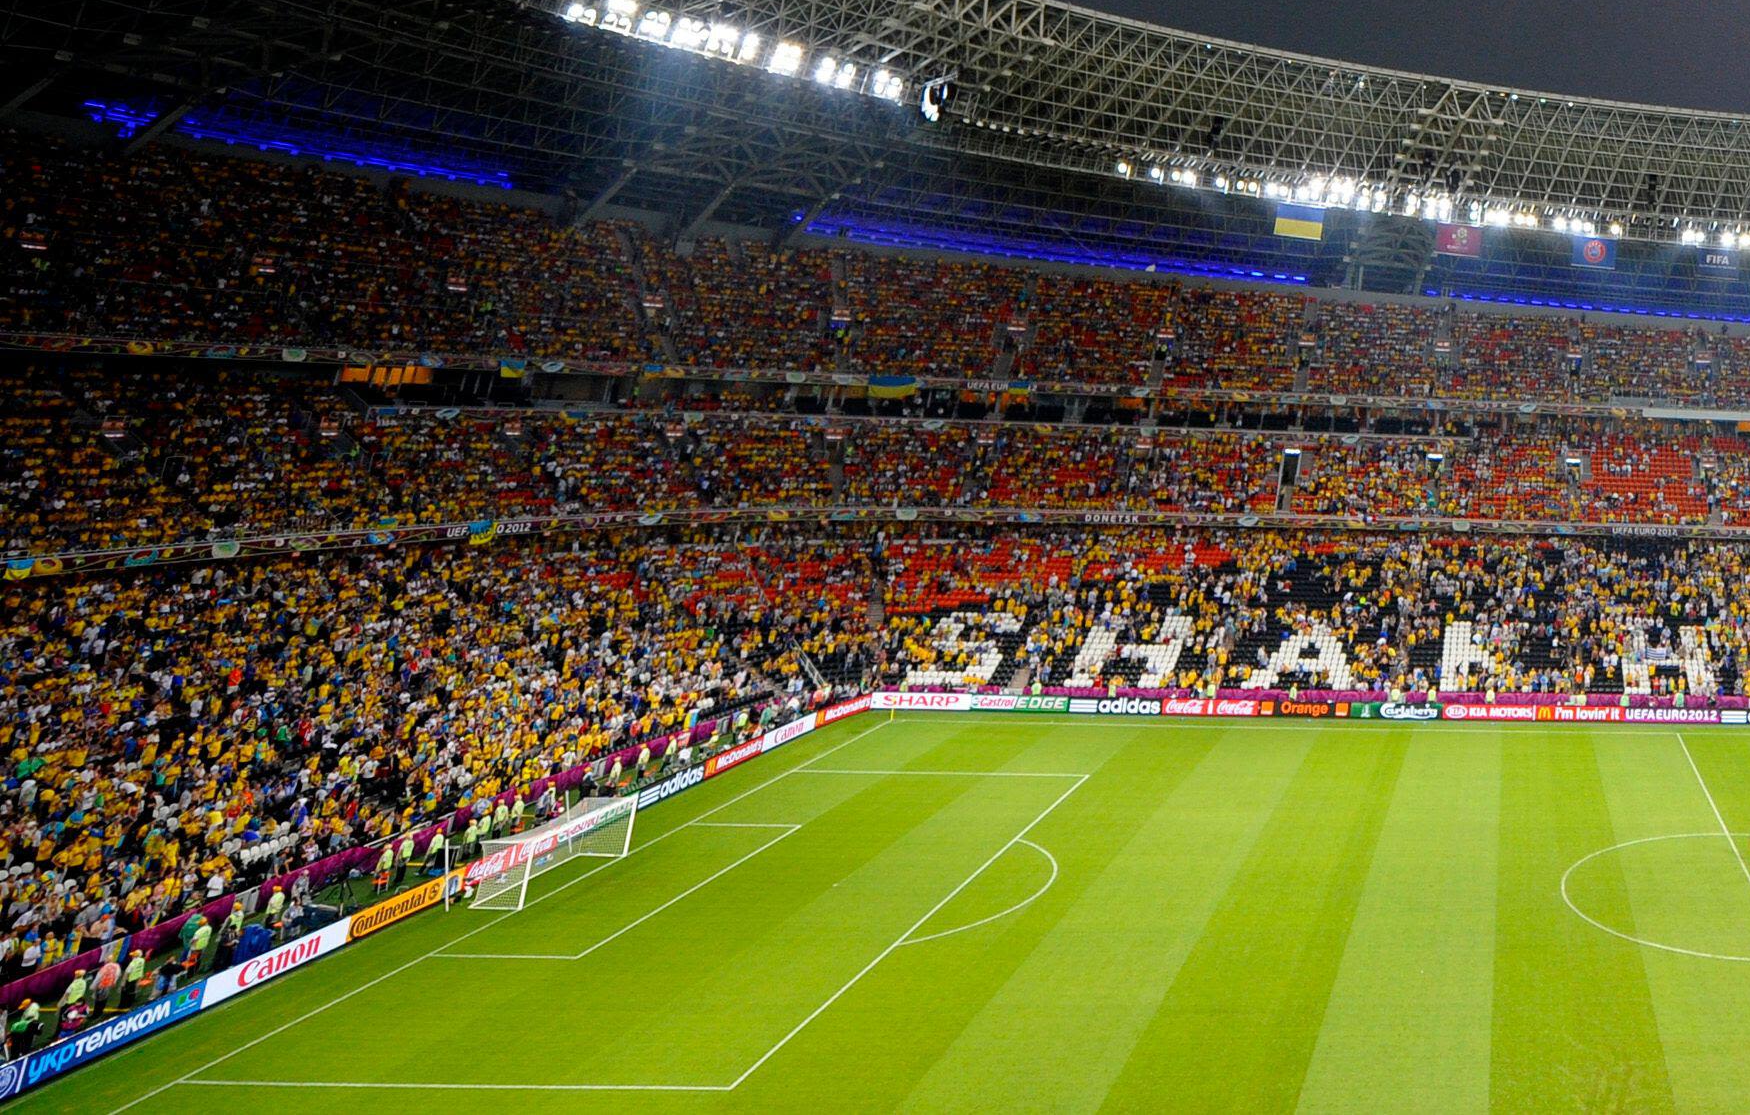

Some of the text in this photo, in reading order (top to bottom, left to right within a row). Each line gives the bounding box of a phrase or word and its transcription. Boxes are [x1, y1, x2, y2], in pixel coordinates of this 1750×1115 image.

[1706, 254, 1729, 266] FIFA
[1084, 514, 1139, 524] DONETSK
[504, 523, 532, 534] 2012
[883, 695, 960, 707] SHARP
[979, 696, 1068, 709] Castrol EDGE
[1098, 697, 1161, 714] adidas
[1281, 702, 1329, 717] Orange
[1380, 703, 1438, 719] Carlsberg
[1469, 706, 1533, 718] KIA MOTORS
[1610, 707, 1620, 720] it
[1688, 709, 1717, 721] 2012
[774, 720, 804, 744] Canon
[659, 764, 705, 798] adidas
[350, 890, 429, 937] Continental
[237, 935, 322, 987] Canon
